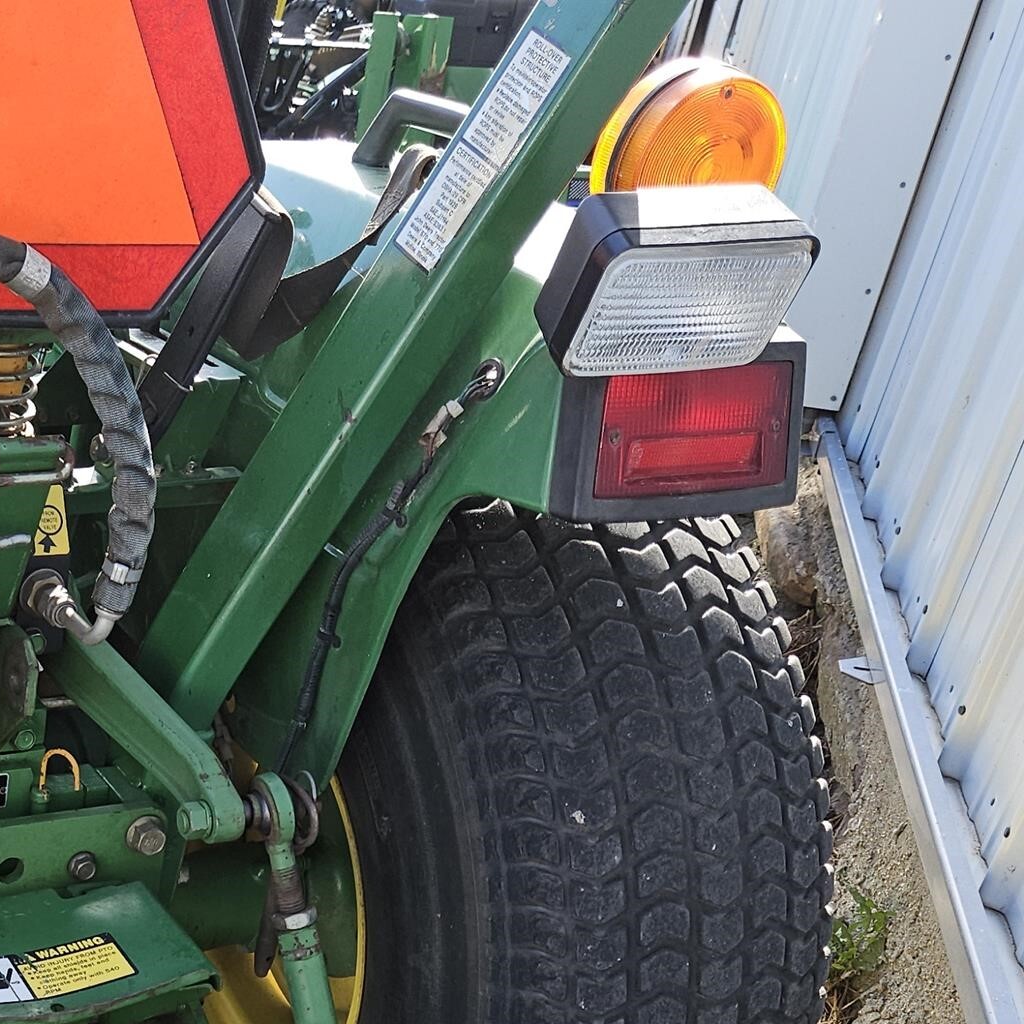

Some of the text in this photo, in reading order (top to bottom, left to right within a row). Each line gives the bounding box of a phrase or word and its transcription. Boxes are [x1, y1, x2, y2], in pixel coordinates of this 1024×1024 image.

[525, 47, 557, 73] PROTECTIVE
[532, 38, 563, 63] ROLL-OVER
[520, 57, 550, 82] STRUCTURE
[522, 85, 530, 93] and
[498, 89, 530, 117] Replace damaged
[449, 155, 472, 175] Performance
[455, 147, 493, 178] CERTIFICATION
[440, 192, 448, 201] Part
[414, 215, 423, 225] John
[422, 222, 434, 233] Deere
[407, 231, 418, 242] Deere
[419, 243, 436, 260] Company
[427, 237, 435, 245] and
[36, 937, 104, 961] WARNING
[47, 956, 73, 966] INJURY
[75, 950, 96, 958] FROM
[63, 959, 87, 967] shields
[36, 972, 54, 980] Keep
[42, 979, 70, 989] Operate
